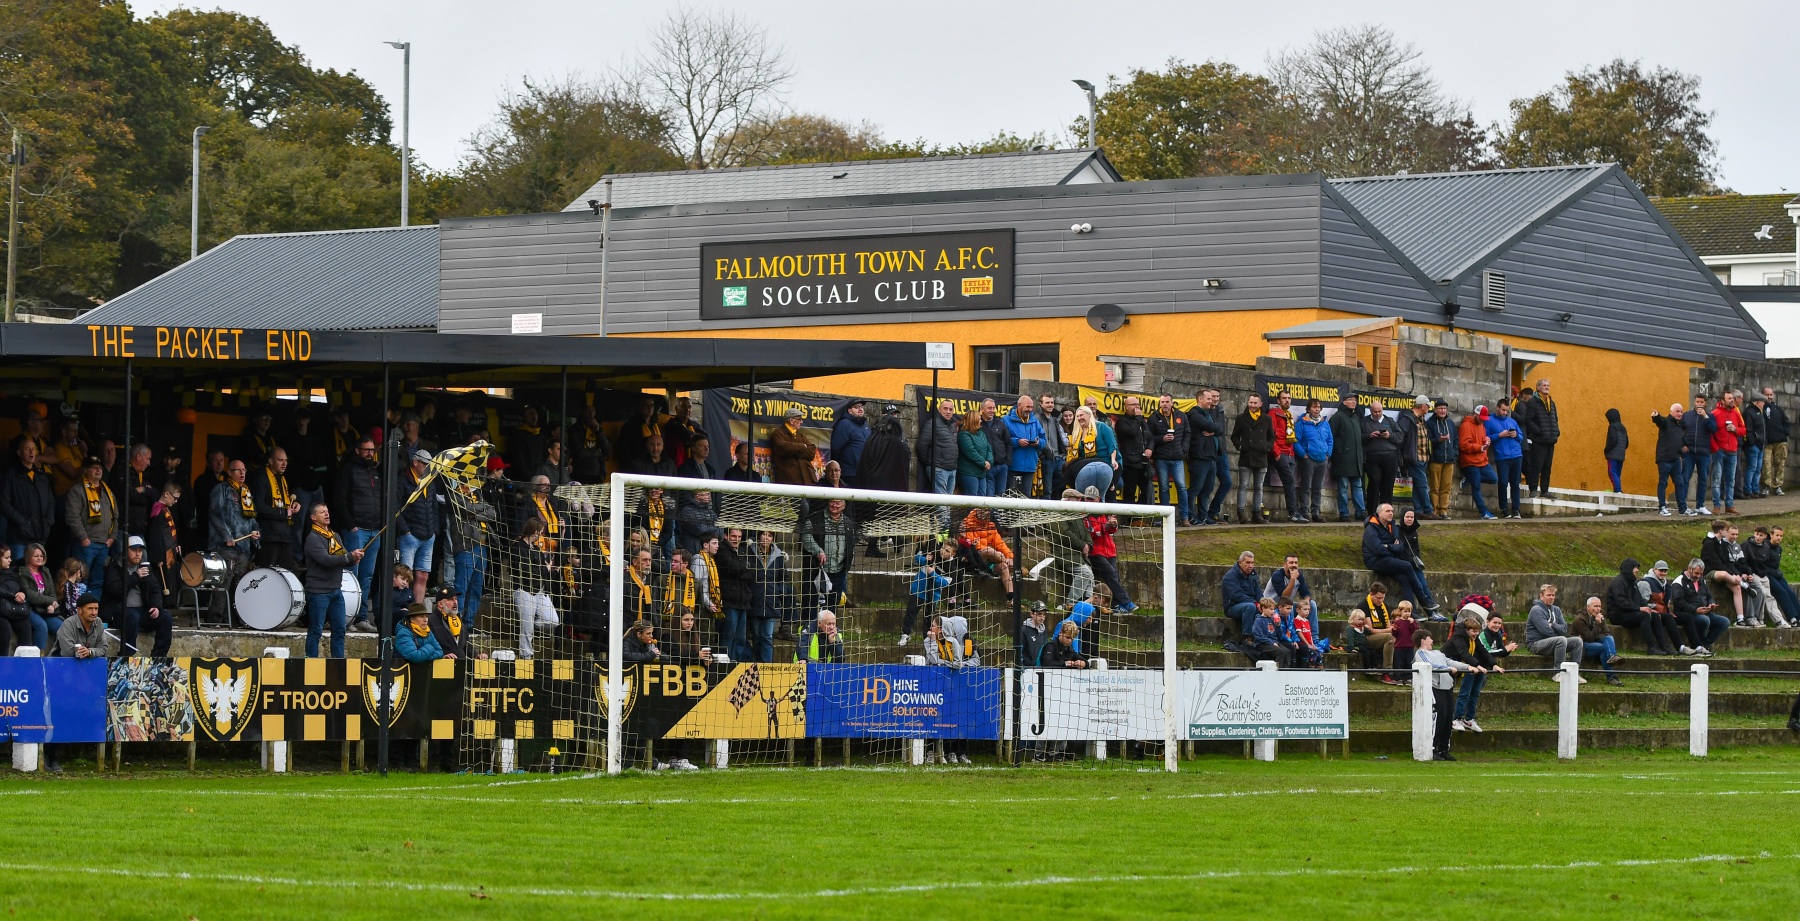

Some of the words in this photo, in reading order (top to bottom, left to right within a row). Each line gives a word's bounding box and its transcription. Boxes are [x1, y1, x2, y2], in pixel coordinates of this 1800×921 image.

[715, 253, 846, 280] FALMOUTH
[855, 250, 926, 274] TOWN
[934, 246, 999, 271] A.F.C.
[762, 284, 859, 306] SOCIAL
[875, 280, 945, 302] CLUB
[87, 325, 135, 357] THE
[156, 327, 243, 360] PACKET
[266, 329, 312, 361] END
[1286, 383, 1308, 400] TREBLE
[1311, 385, 1340, 402] WINNERS
[809, 405, 834, 421] 2022
[643, 664, 708, 697] FBB
[893, 679, 918, 692] HINE
[1117, 676, 1144, 684] Associates
[1284, 684, 1318, 695] Eastwood
[1319, 684, 1335, 695] Park
[263, 690, 275, 710] F
[279, 690, 348, 710] TROOP
[470, 687, 534, 714] FTFC
[862, 678, 891, 704] HD
[893, 693, 944, 706] DOWNING
[191, 683, 204, 715] FALMOUTH
[201, 715, 214, 731] TOWN
[1217, 692, 1260, 714] Bailey's
[1278, 697, 1291, 706] Just
[1292, 696, 1300, 705] off
[1300, 697, 1320, 708] Penryn
[1321, 697, 1340, 708] Bridge
[234, 702, 253, 731] FOOTBALL
[893, 707, 938, 717] SOLICITORS
[1217, 709, 1249, 723] Country
[1249, 709, 1271, 721] Store
[1286, 709, 1308, 719] 01326
[1309, 709, 1333, 719] 379888
[1191, 726, 1201, 736] Pet
[1201, 726, 1227, 737] Supplies,
[1227, 726, 1257, 737] Gardening,
[1258, 726, 1284, 737] Clothing,
[1284, 726, 1309, 736] Footwear
[1310, 726, 1315, 736] &
[1315, 726, 1343, 736] Hardware.
